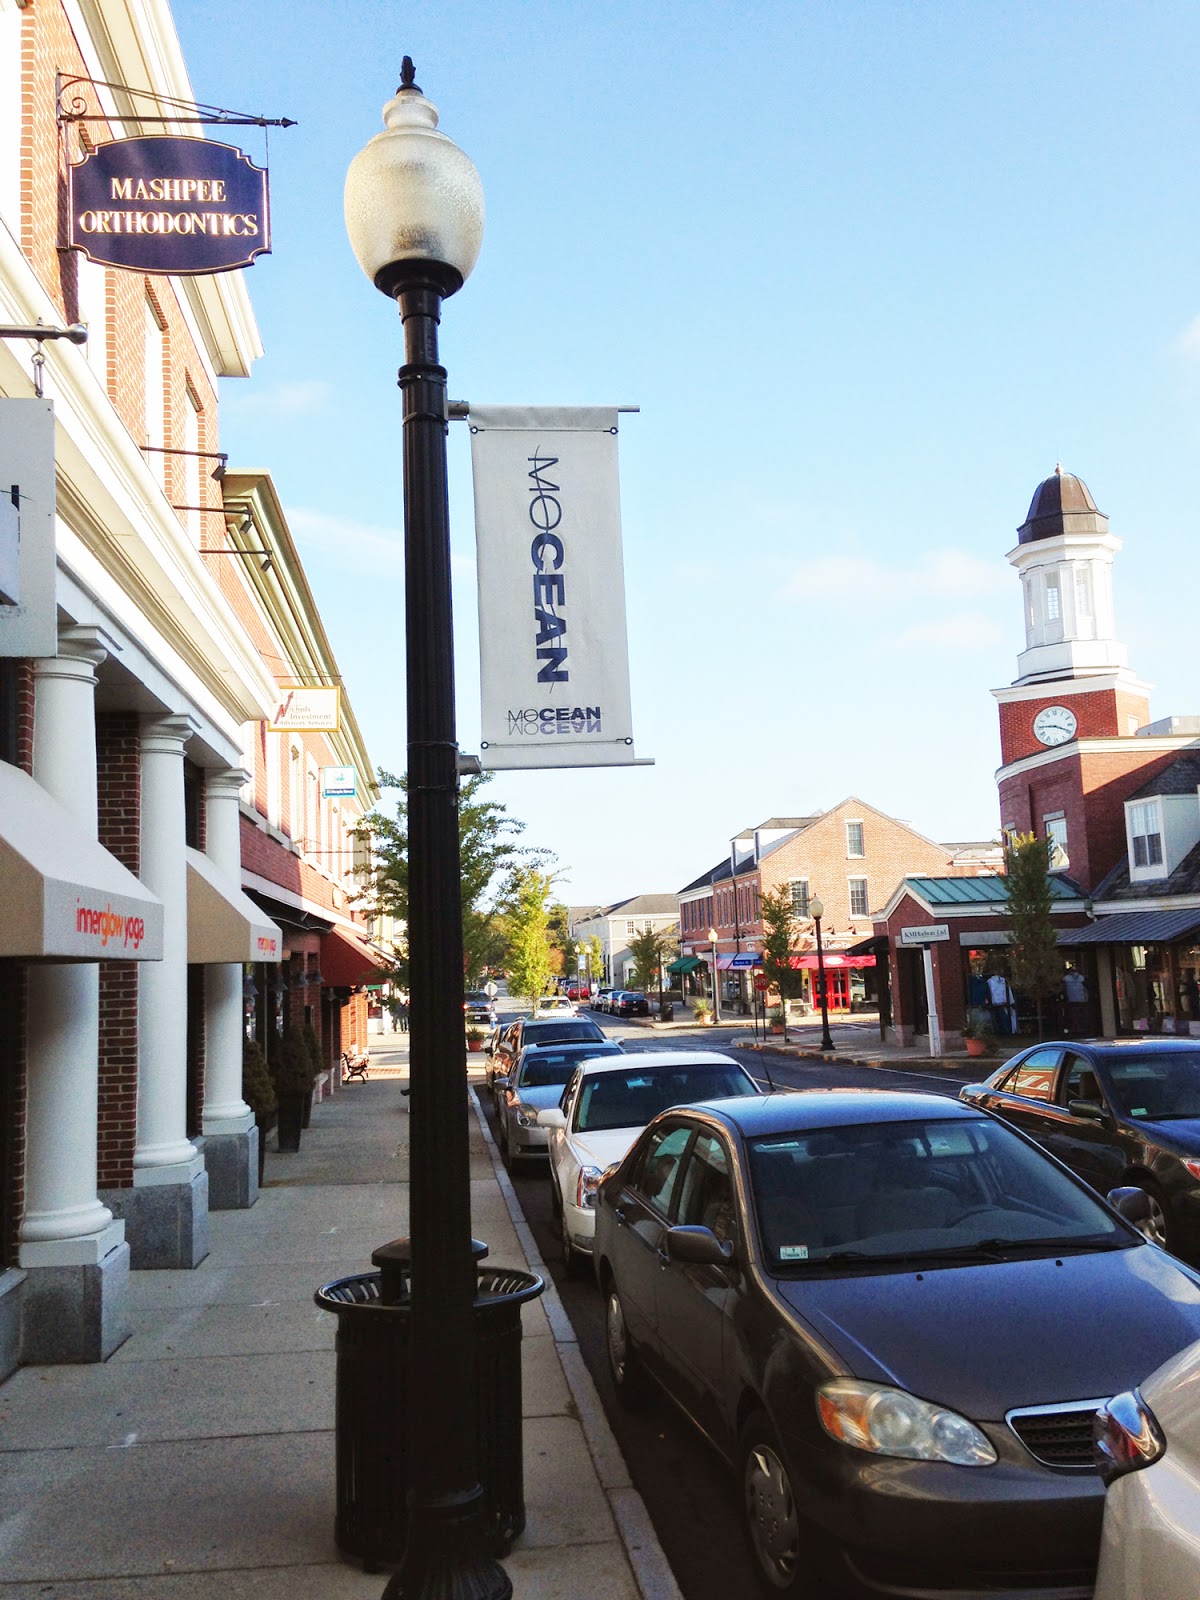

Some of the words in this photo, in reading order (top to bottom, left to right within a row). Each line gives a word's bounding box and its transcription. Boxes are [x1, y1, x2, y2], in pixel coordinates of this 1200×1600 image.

[111, 178, 227, 202] MASHPEE
[79, 210, 258, 236] ORTHODONTICS
[527, 457, 569, 683] MOCEAN
[508, 707, 601, 722] MOCEAN
[76, 897, 123, 947] innerglow
[123, 916, 145, 949] yoga
